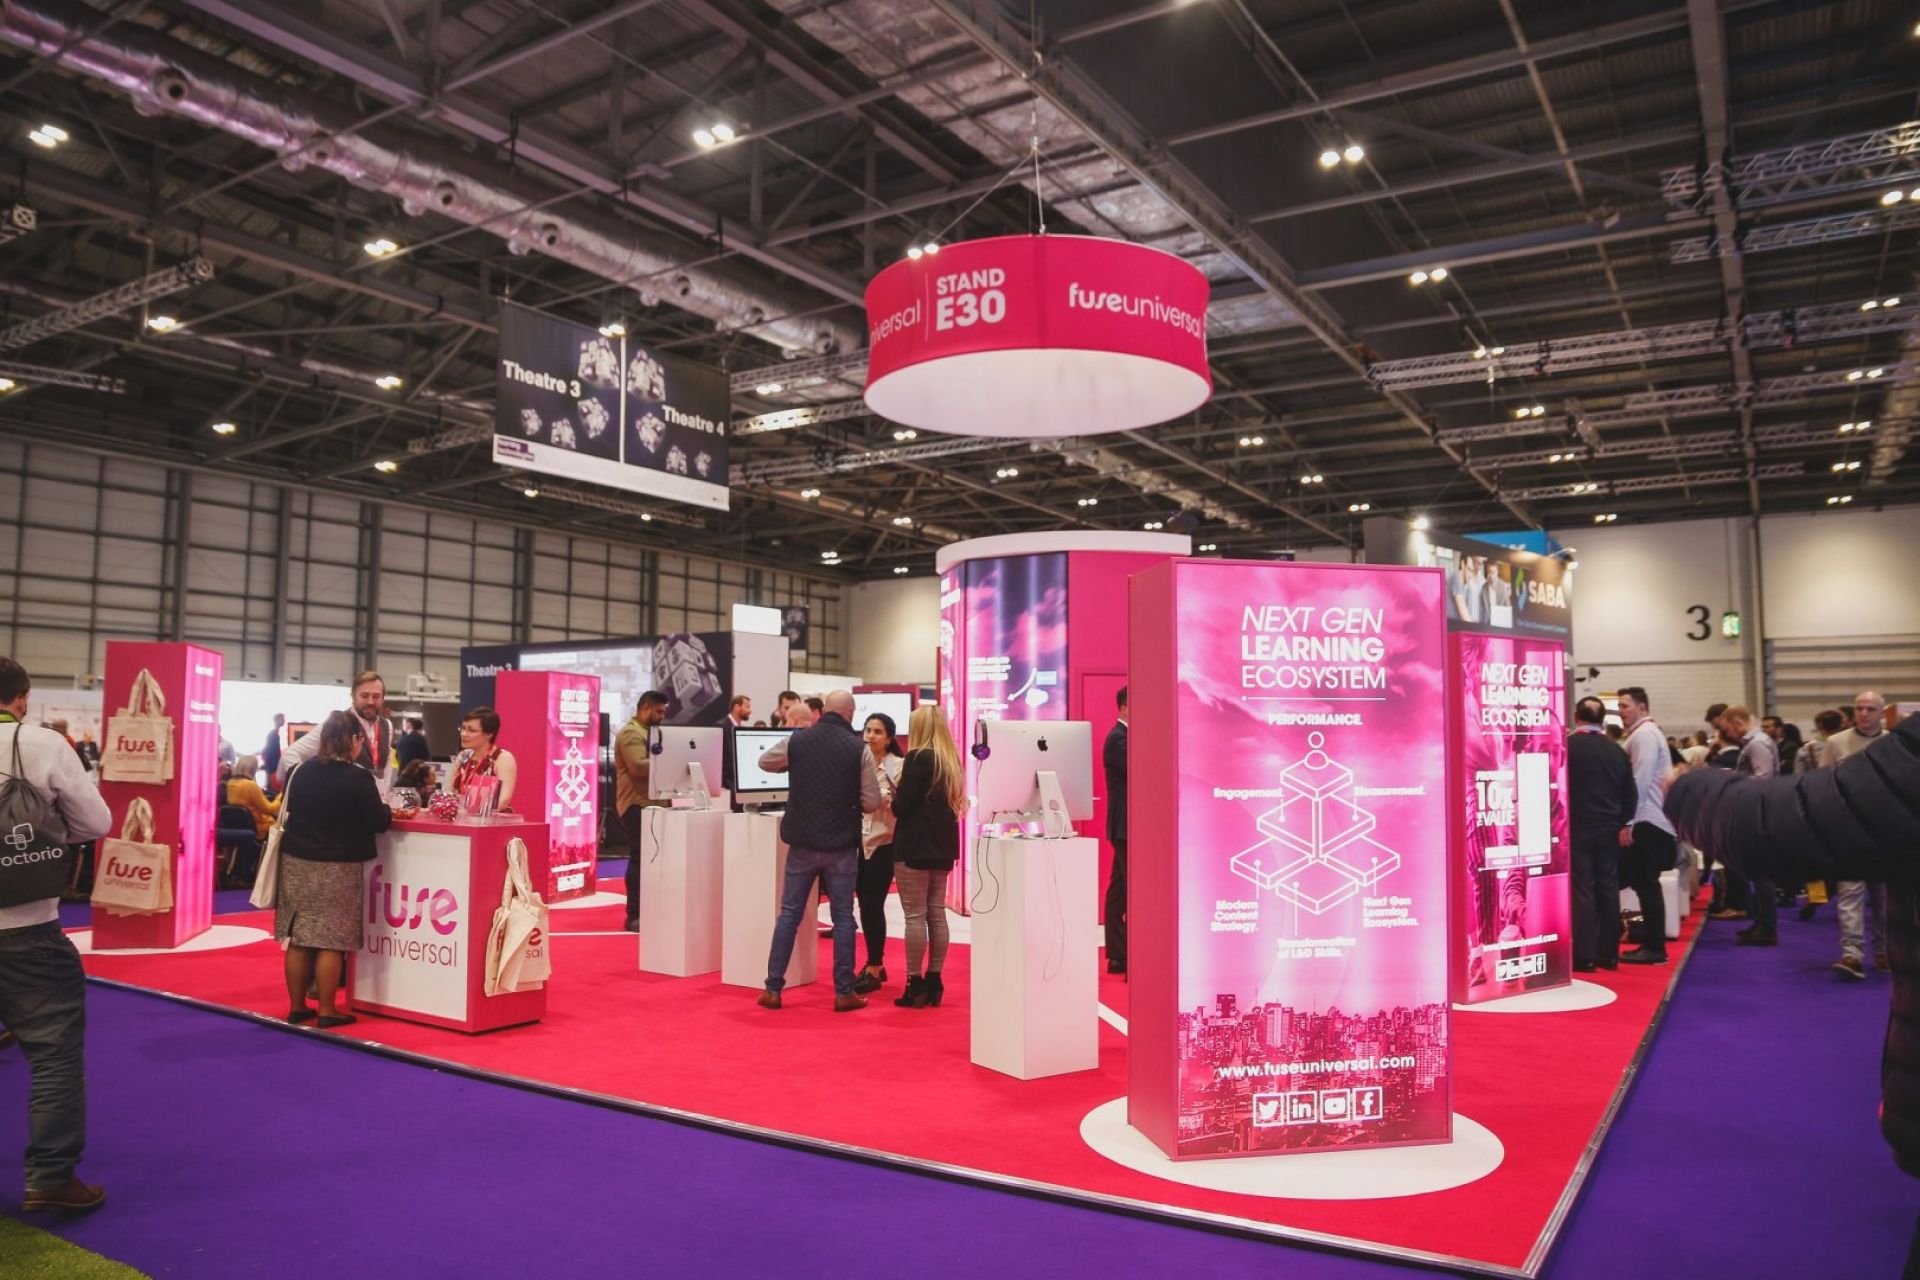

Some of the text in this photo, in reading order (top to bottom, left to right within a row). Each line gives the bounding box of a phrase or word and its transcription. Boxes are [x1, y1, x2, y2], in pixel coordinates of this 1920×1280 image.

[936, 268, 1006, 296] STAND
[936, 289, 1006, 332] E30
[503, 359, 581, 398] Theatre 3
[661, 404, 724, 436] Theatre 4
[1528, 580, 1567, 609] SABA
[1241, 605, 1384, 634] NEXT GEN
[1686, 605, 1712, 641] 3
[1241, 635, 1385, 662] LEARNING
[1242, 665, 1386, 689] ECOSYSTEM
[1482, 707, 1550, 727] ECOSYSTEM
[116, 735, 156, 752] fuse
[106, 857, 153, 881] fuse
[368, 864, 458, 935] fuse
[367, 931, 457, 967] universal
[1218, 1055, 1415, 1079] www.fuseuniversal.com
